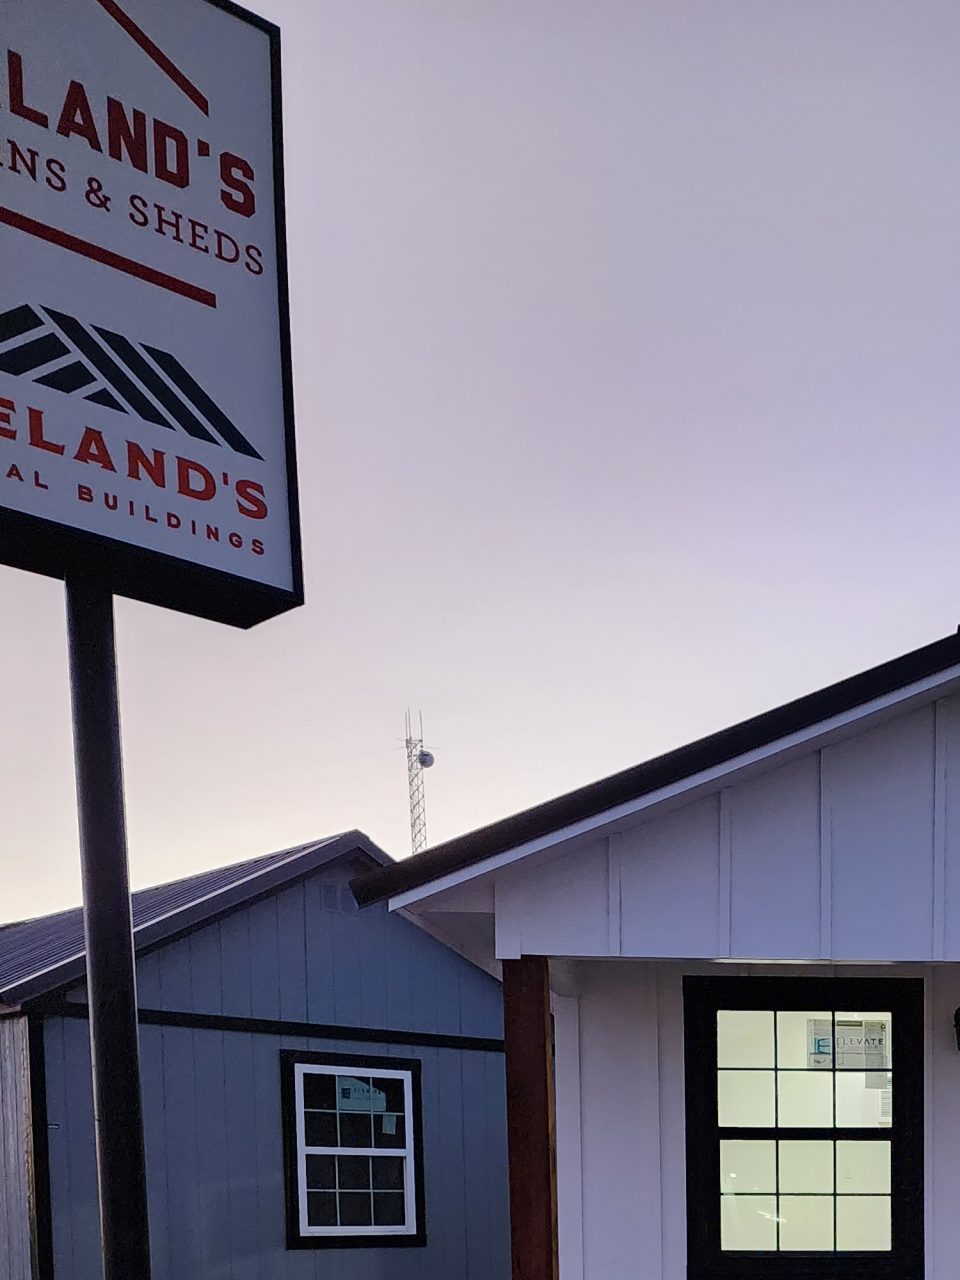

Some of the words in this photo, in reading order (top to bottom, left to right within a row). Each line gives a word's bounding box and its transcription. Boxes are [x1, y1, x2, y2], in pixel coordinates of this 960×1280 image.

[7, 49, 256, 218] LAND'S
[0, 138, 67, 192] NS
[84, 176, 111, 212] &
[129, 194, 264, 275] SHEDS
[6, 463, 49, 490] AL
[78, 484, 265, 556] BUILDINGS
[836, 1037, 884, 1046] ELEVATE
